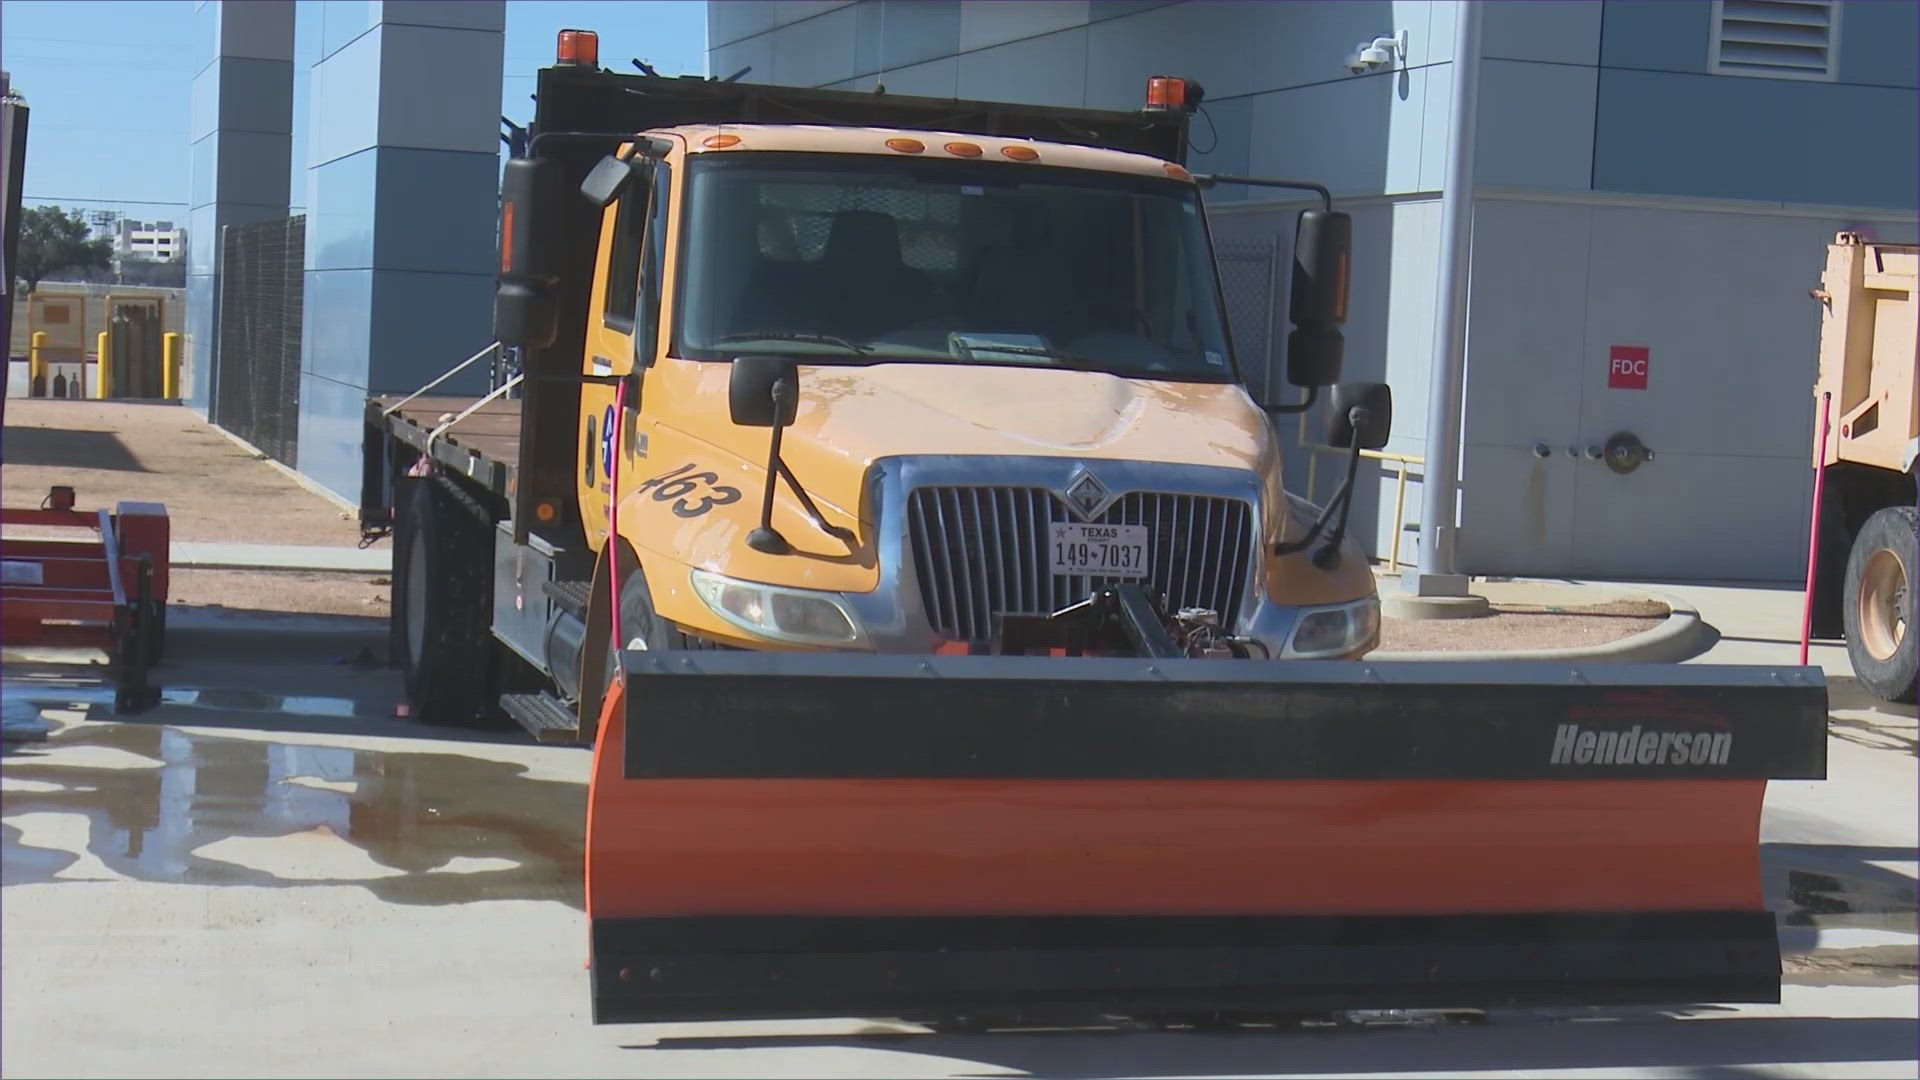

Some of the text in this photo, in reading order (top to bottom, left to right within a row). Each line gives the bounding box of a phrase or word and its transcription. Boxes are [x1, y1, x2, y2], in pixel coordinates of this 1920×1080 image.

[1611, 358, 1646, 376] FDC
[638, 463, 742, 519] 463
[1080, 527, 1118, 538] TEXAS
[1550, 724, 1732, 766] Henderson
